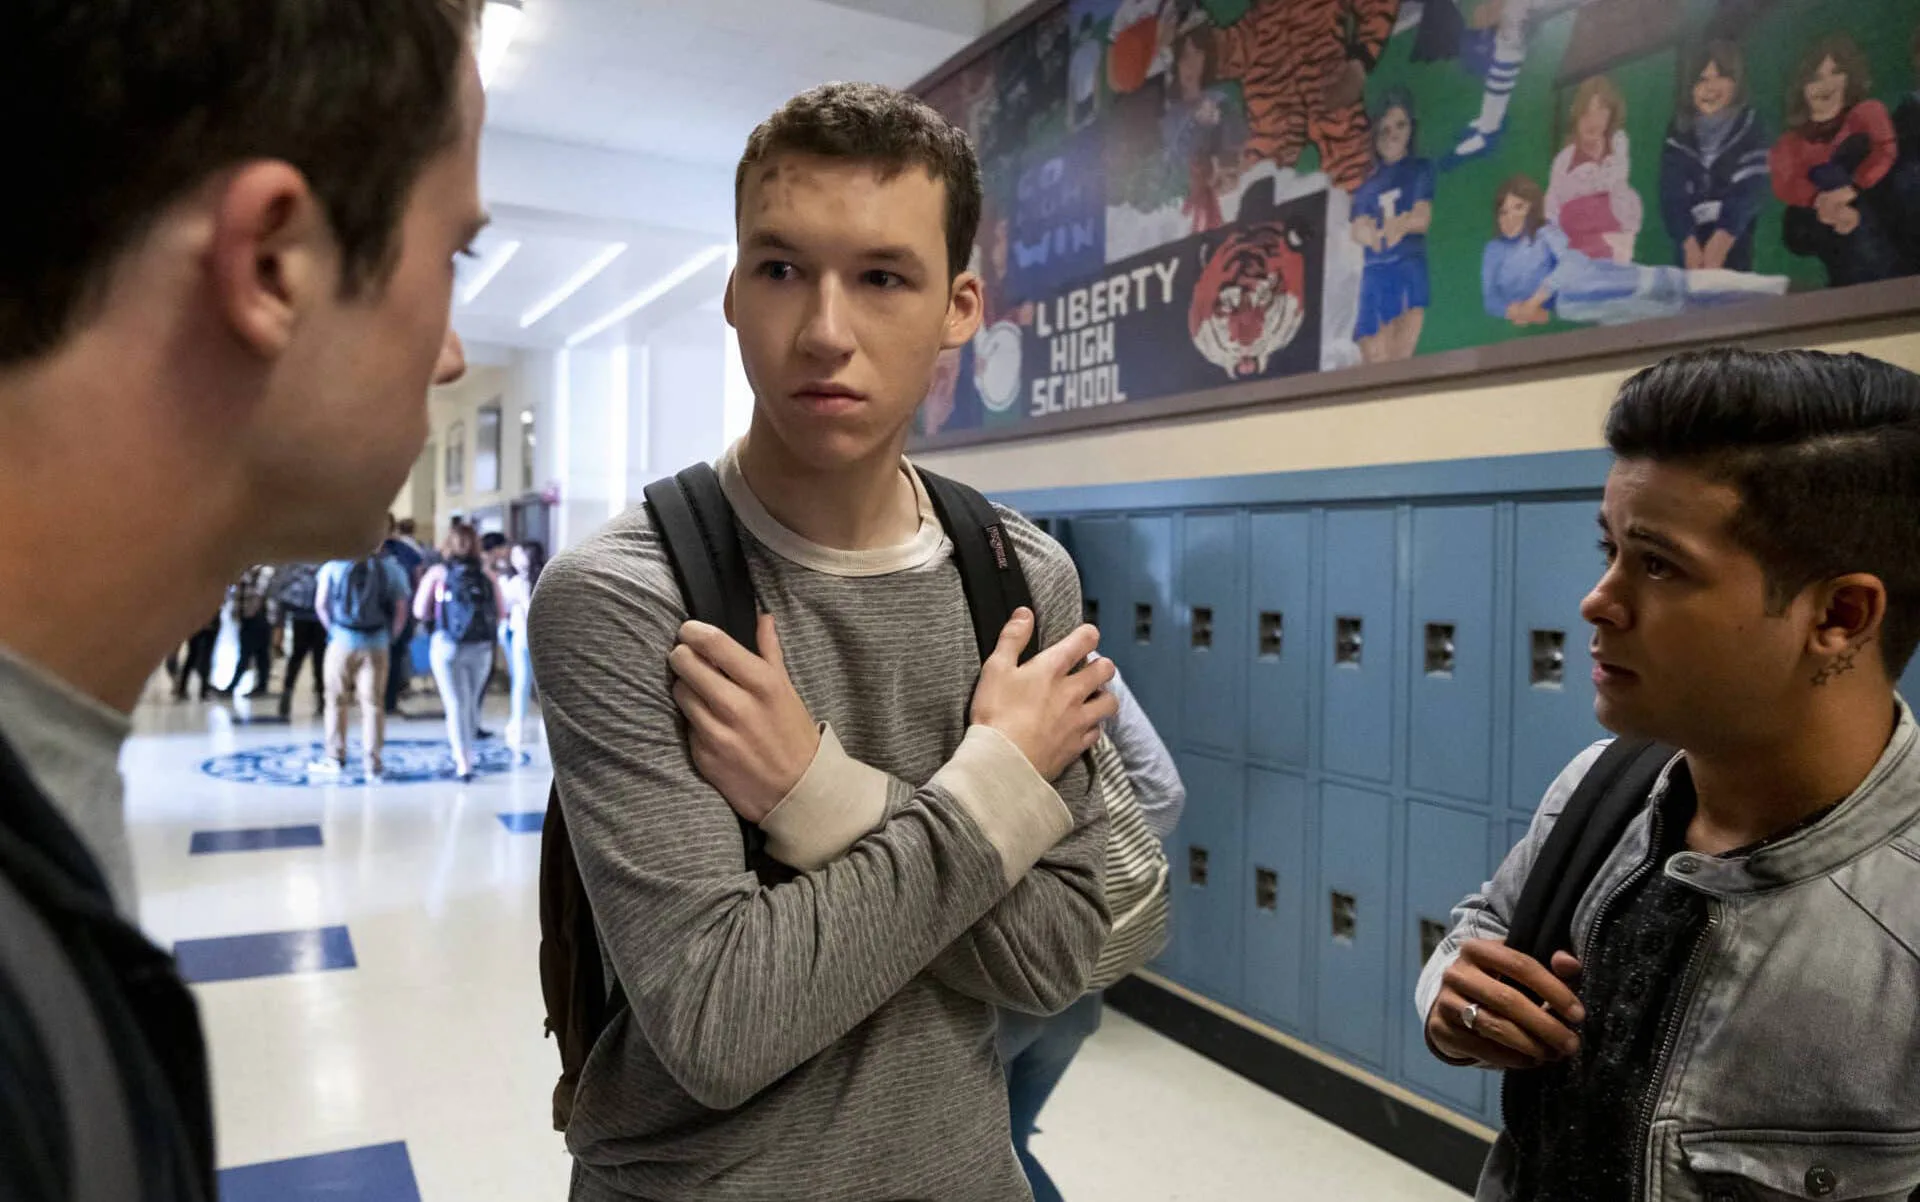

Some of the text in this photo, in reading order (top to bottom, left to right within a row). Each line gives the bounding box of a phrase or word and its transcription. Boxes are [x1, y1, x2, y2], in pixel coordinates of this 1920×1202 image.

[1013, 217, 1094, 268] WIN
[1037, 257, 1179, 338] LIBERTY
[1051, 321, 1115, 373] HIGH
[1029, 363, 1127, 417] SCHOOL
